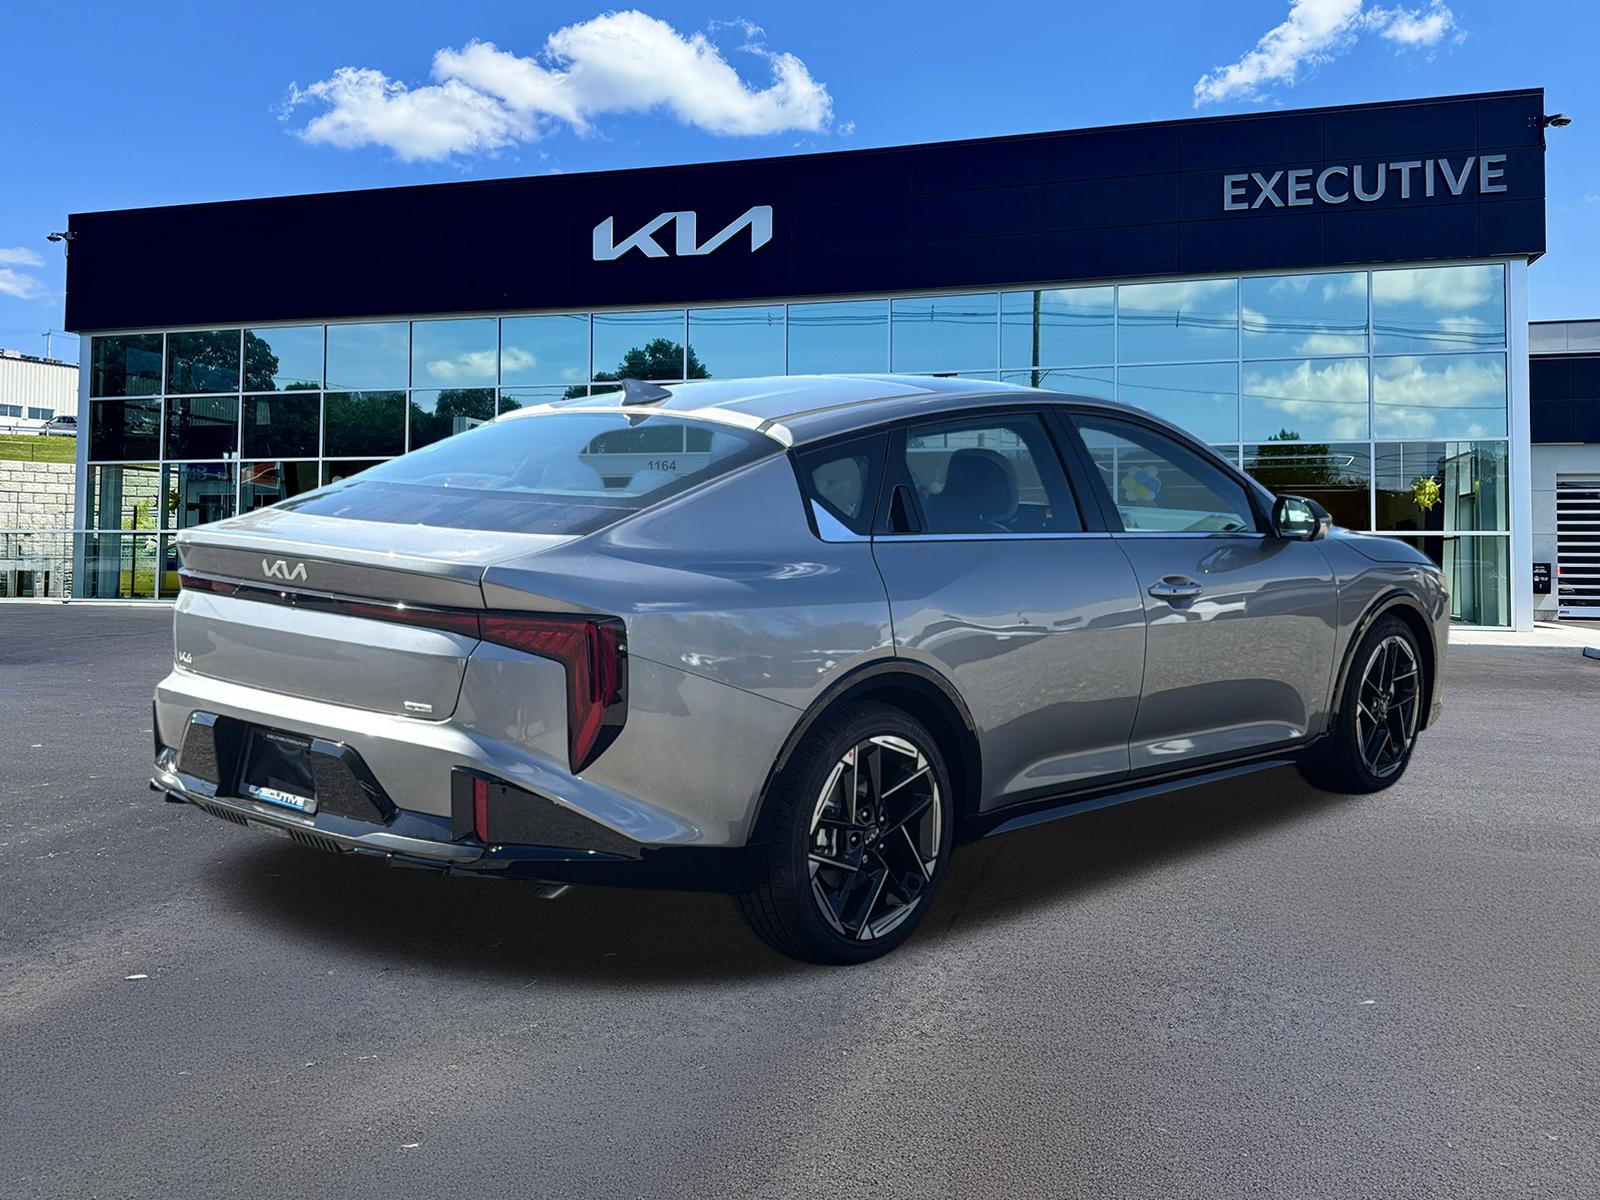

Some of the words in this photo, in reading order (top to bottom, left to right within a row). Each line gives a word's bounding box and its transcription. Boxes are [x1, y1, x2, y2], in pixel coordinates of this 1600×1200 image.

[1223, 154, 1508, 211] EXECUTIVE
[593, 205, 773, 261] KIA
[647, 459, 677, 472] 1164
[261, 558, 308, 582] KIA
[178, 650, 193, 664] K4
